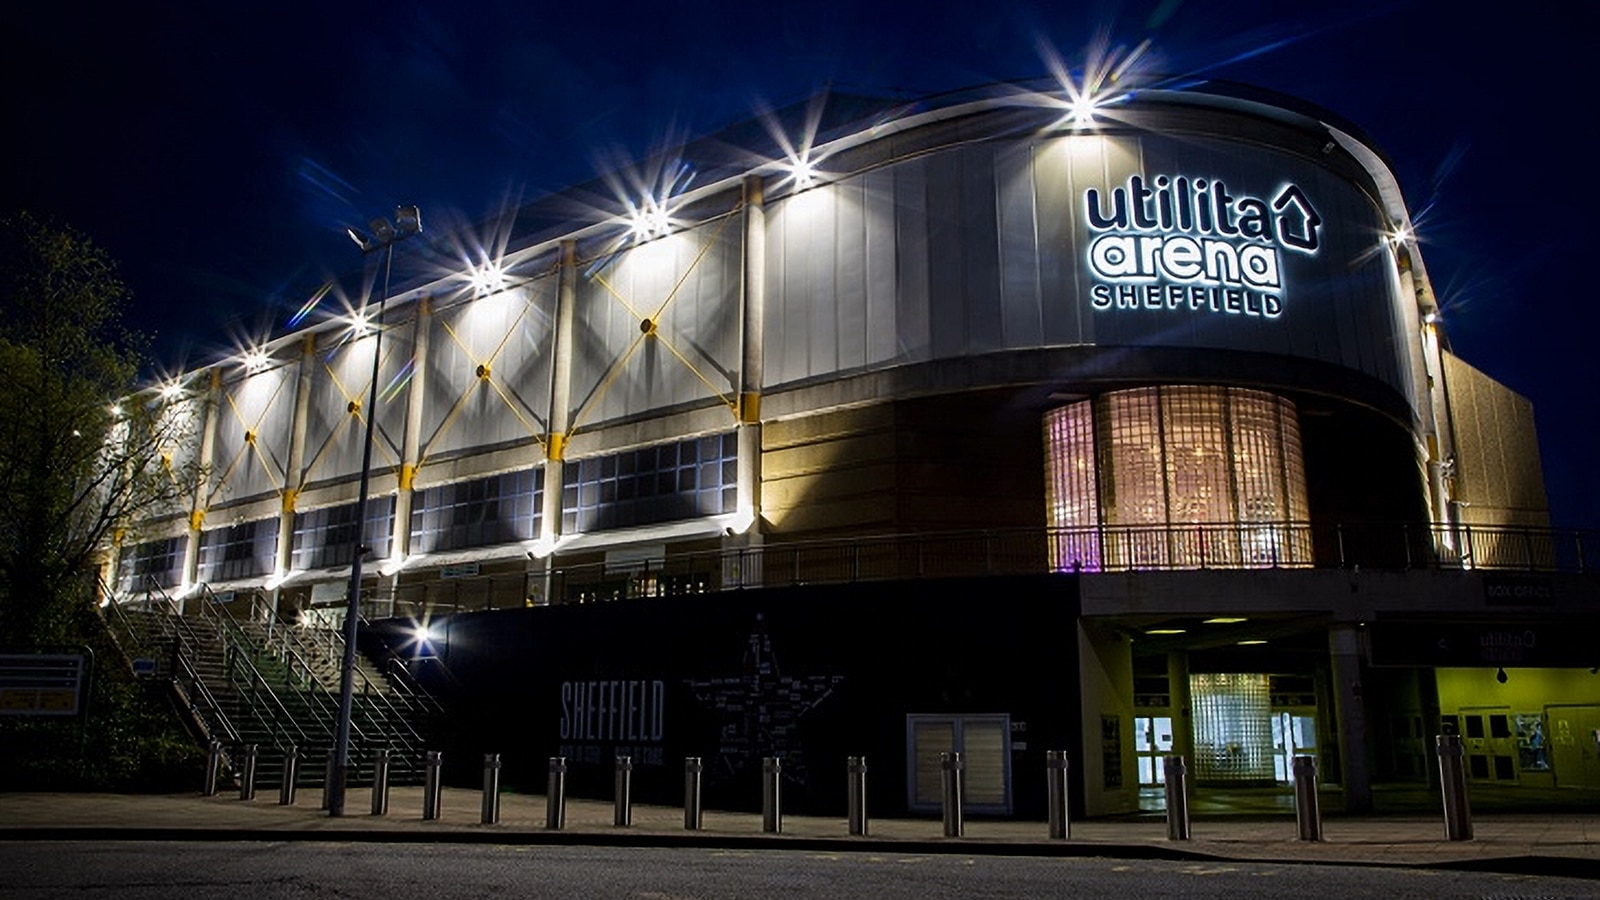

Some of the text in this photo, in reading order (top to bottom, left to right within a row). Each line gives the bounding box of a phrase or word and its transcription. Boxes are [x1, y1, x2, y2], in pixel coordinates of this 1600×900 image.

[1086, 174, 1273, 243] utilita
[1090, 233, 1281, 289] arena
[1092, 285, 1283, 317] SHEFFIELD
[560, 680, 665, 742] SHEFFIELD
